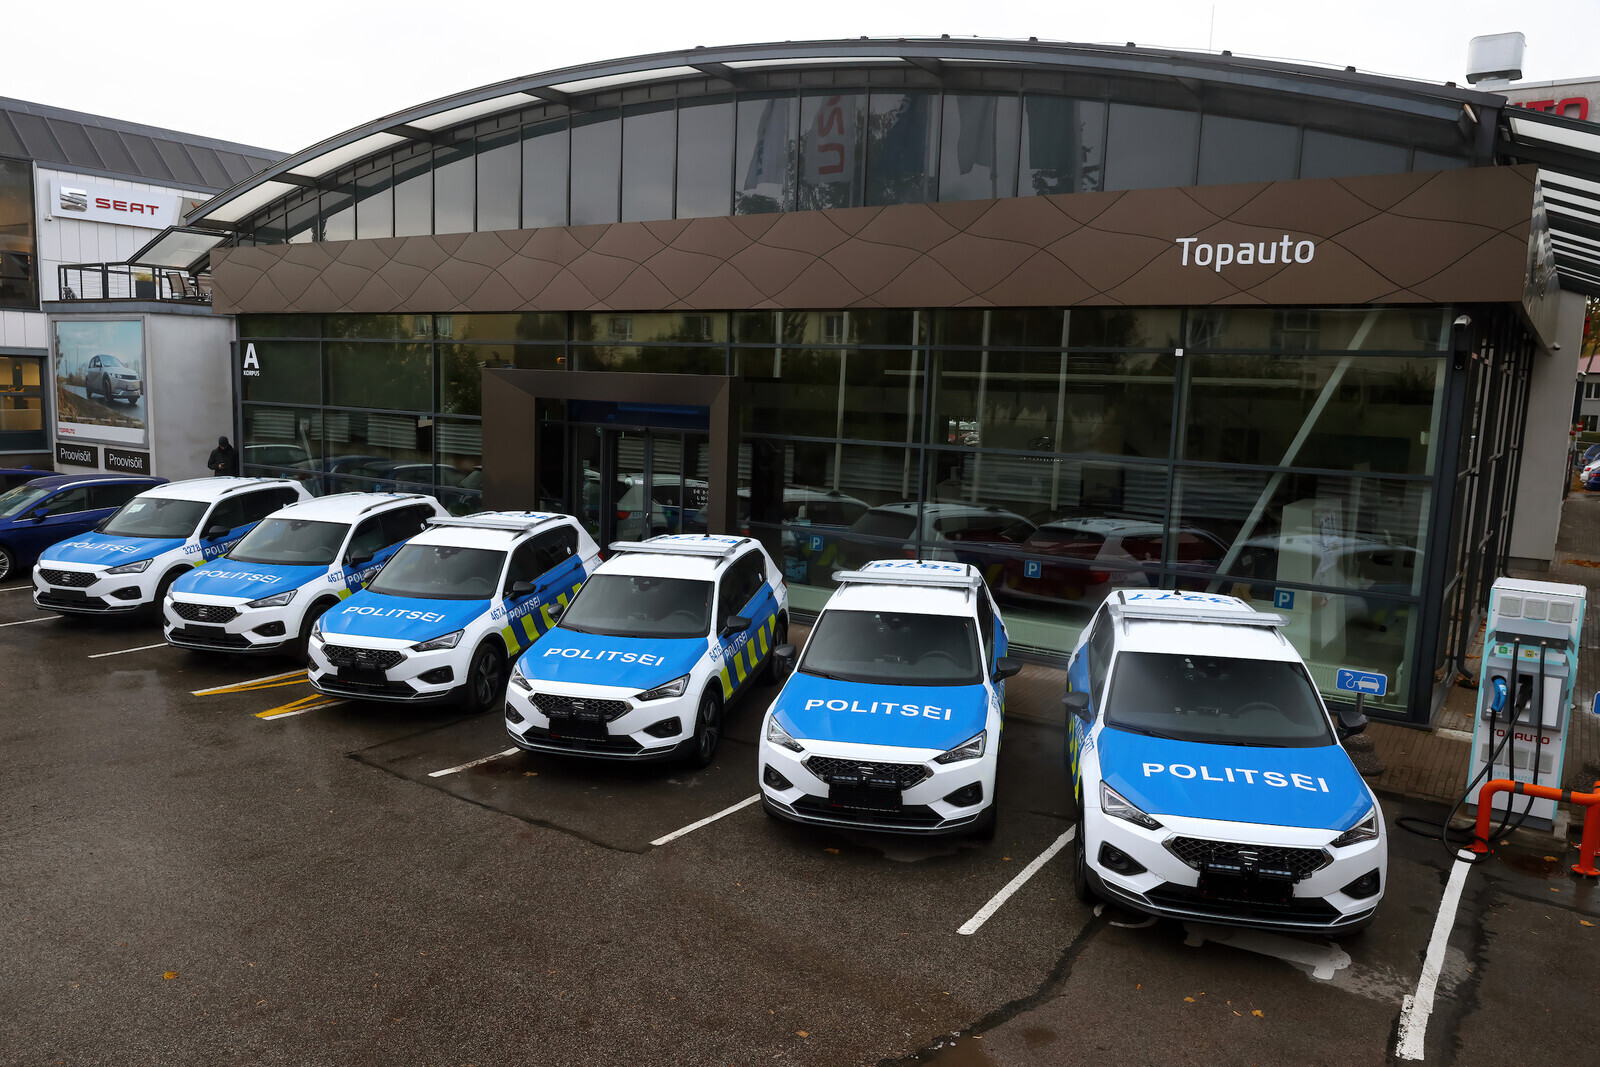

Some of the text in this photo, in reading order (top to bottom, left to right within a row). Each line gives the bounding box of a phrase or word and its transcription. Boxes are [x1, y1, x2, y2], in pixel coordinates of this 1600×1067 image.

[95, 198, 159, 215] SEAT
[1175, 234, 1315, 272] Topauto
[243, 342, 260, 369] A
[60, 447, 92, 463] Proovisõit
[109, 453, 143, 469] Proovisõit
[62, 541, 142, 554] POLITSEI
[193, 570, 283, 584] POLITSEI
[341, 606, 446, 623] POLITSEI
[509, 596, 541, 621] POLITSEI
[542, 648, 665, 667] POLITSEI
[804, 698, 952, 721] POLITSEI
[1142, 762, 1330, 793] POLITSEI
